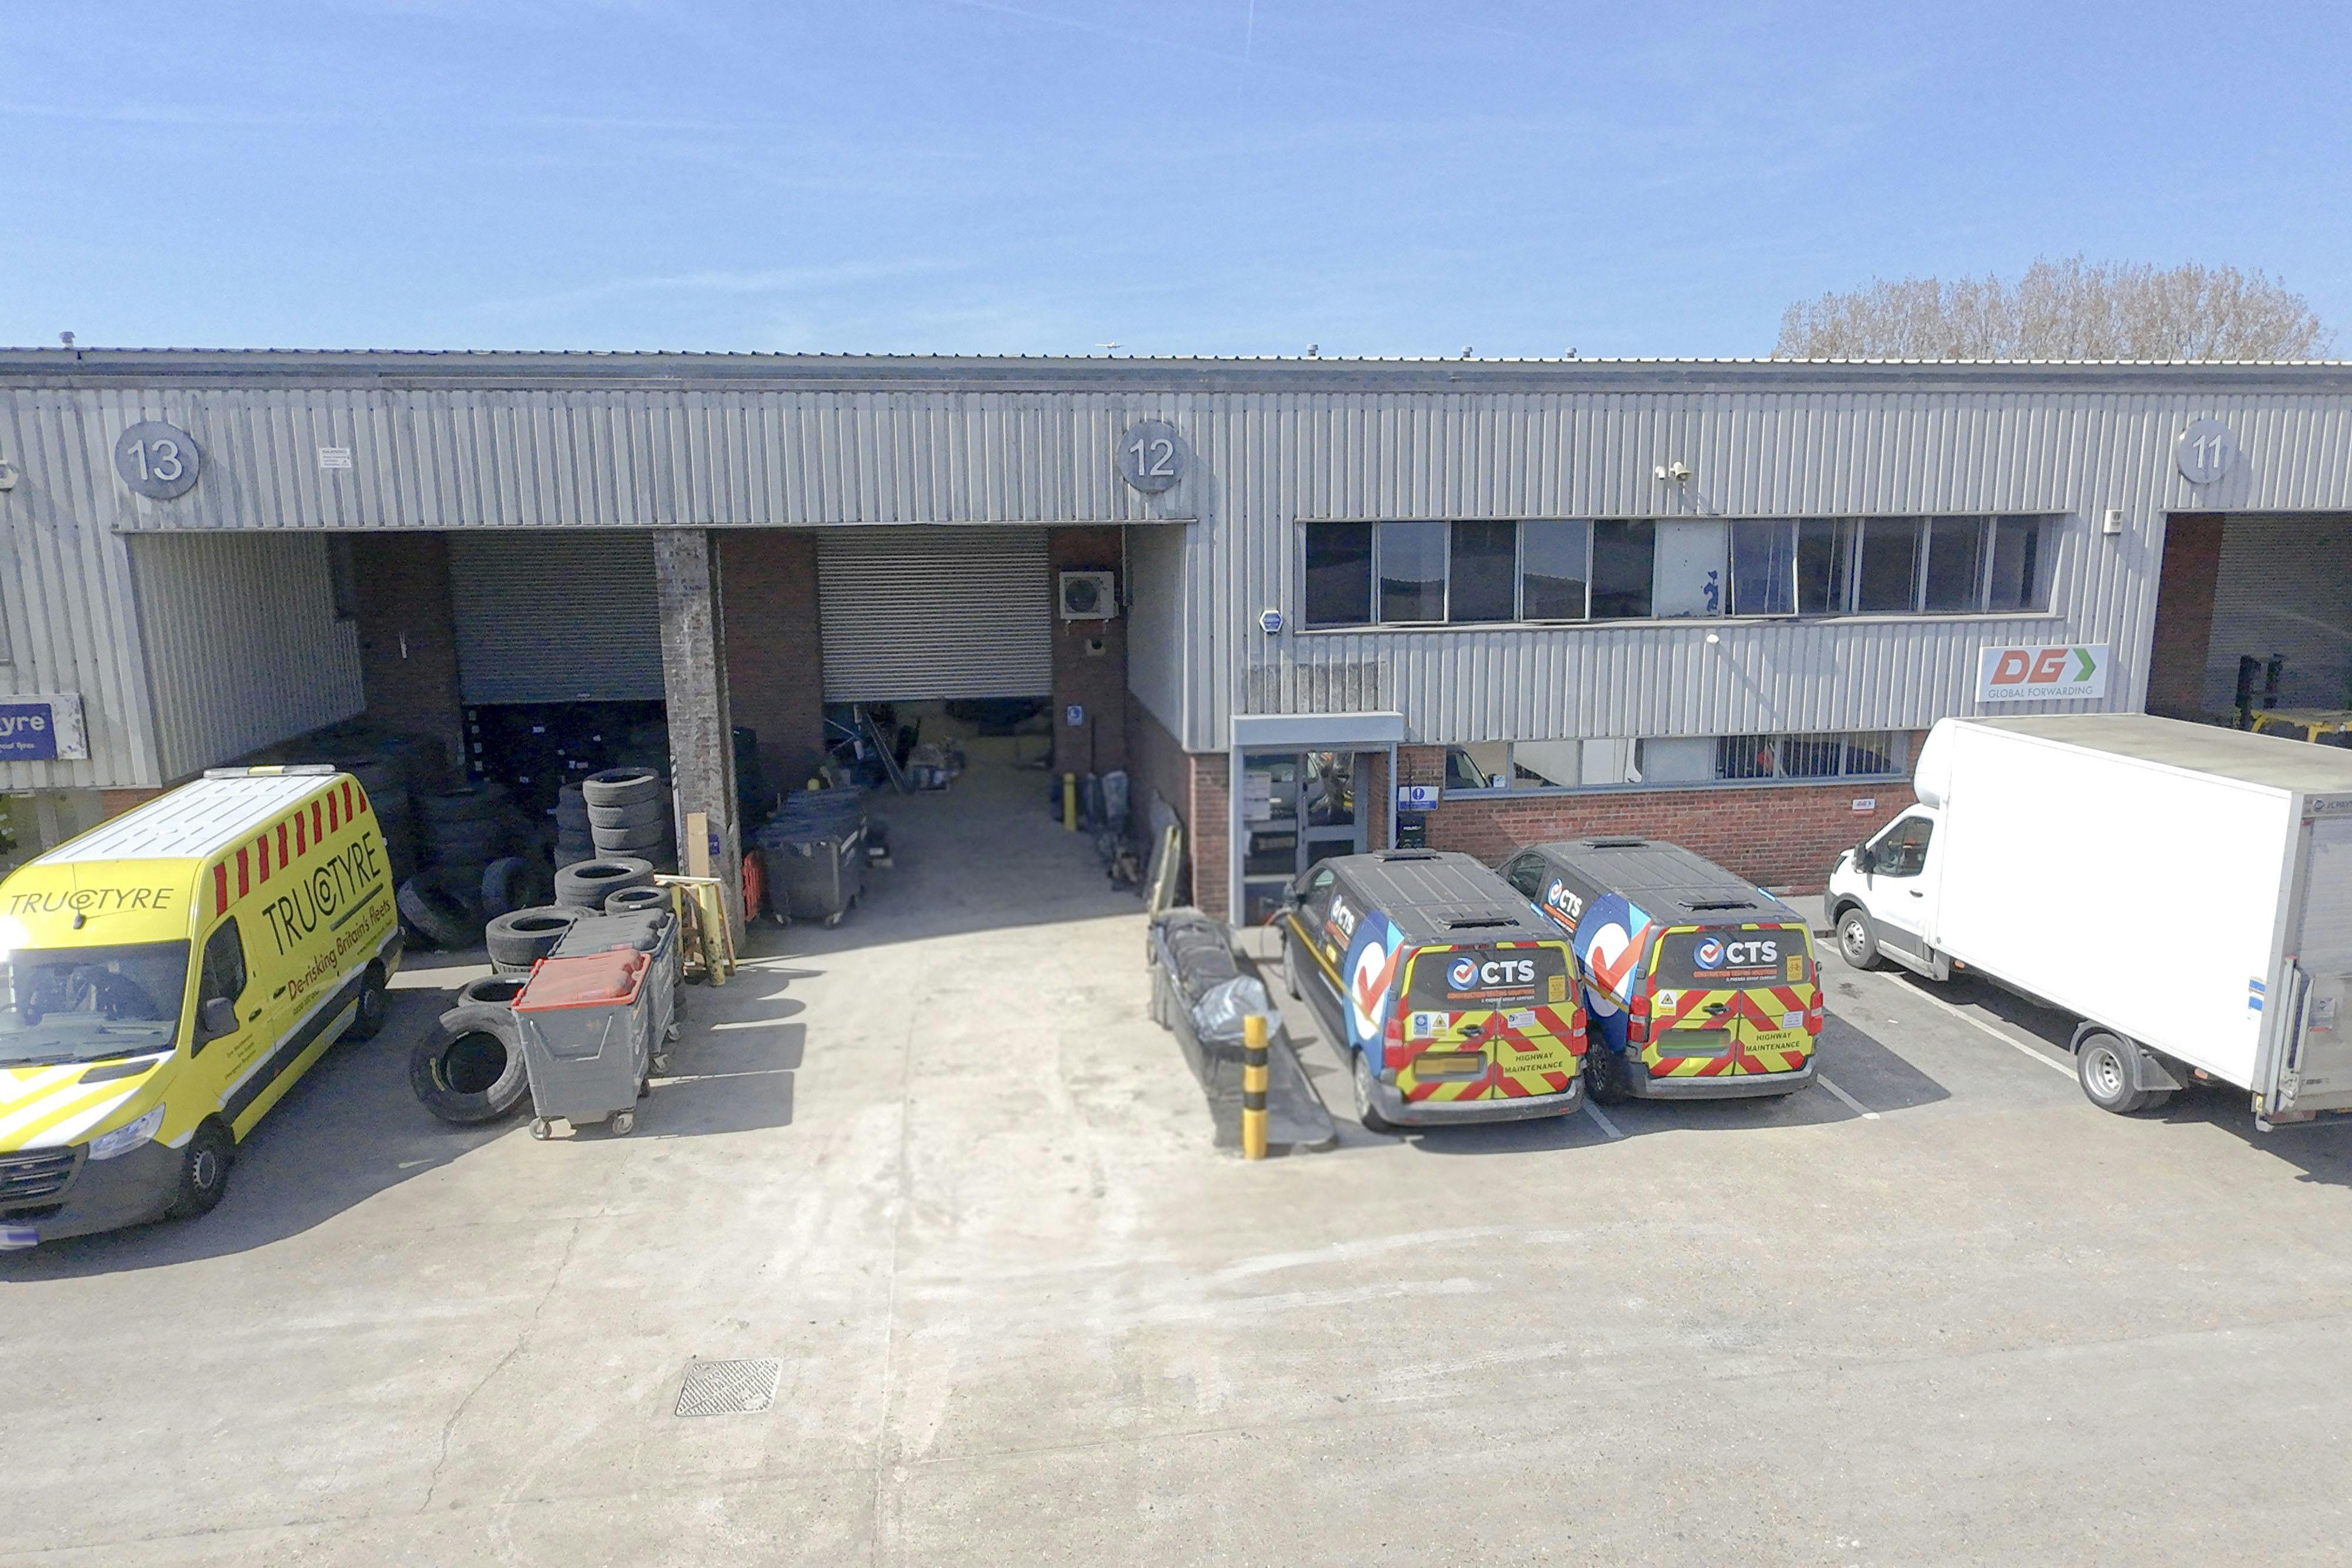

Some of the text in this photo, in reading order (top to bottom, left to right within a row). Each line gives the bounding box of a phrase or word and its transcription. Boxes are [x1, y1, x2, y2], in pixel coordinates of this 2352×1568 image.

[127, 439, 182, 481] 13
[1130, 438, 1174, 476] 12
[2193, 435, 2221, 468] 11
[1990, 648, 2070, 685] DG
[1988, 686, 2093, 698] GLOBAL FORWARDING
[0, 715, 45, 737] yre
[1559, 889, 1582, 917] CTS
[1338, 905, 1355, 935] CTS
[288, 949, 338, 1002] De-risking
[336, 915, 370, 955] Britain's
[369, 900, 391, 931] fleets
[1726, 941, 1778, 964] CTS
[1481, 960, 1535, 984] CTS
[1746, 1041, 1800, 1052] MAINTENANCE
[1756, 1032, 1792, 1042] HIGHWAY
[1505, 1061, 1563, 1073] MAINTENANCE
[1515, 1052, 1554, 1062] HIGHWAY
